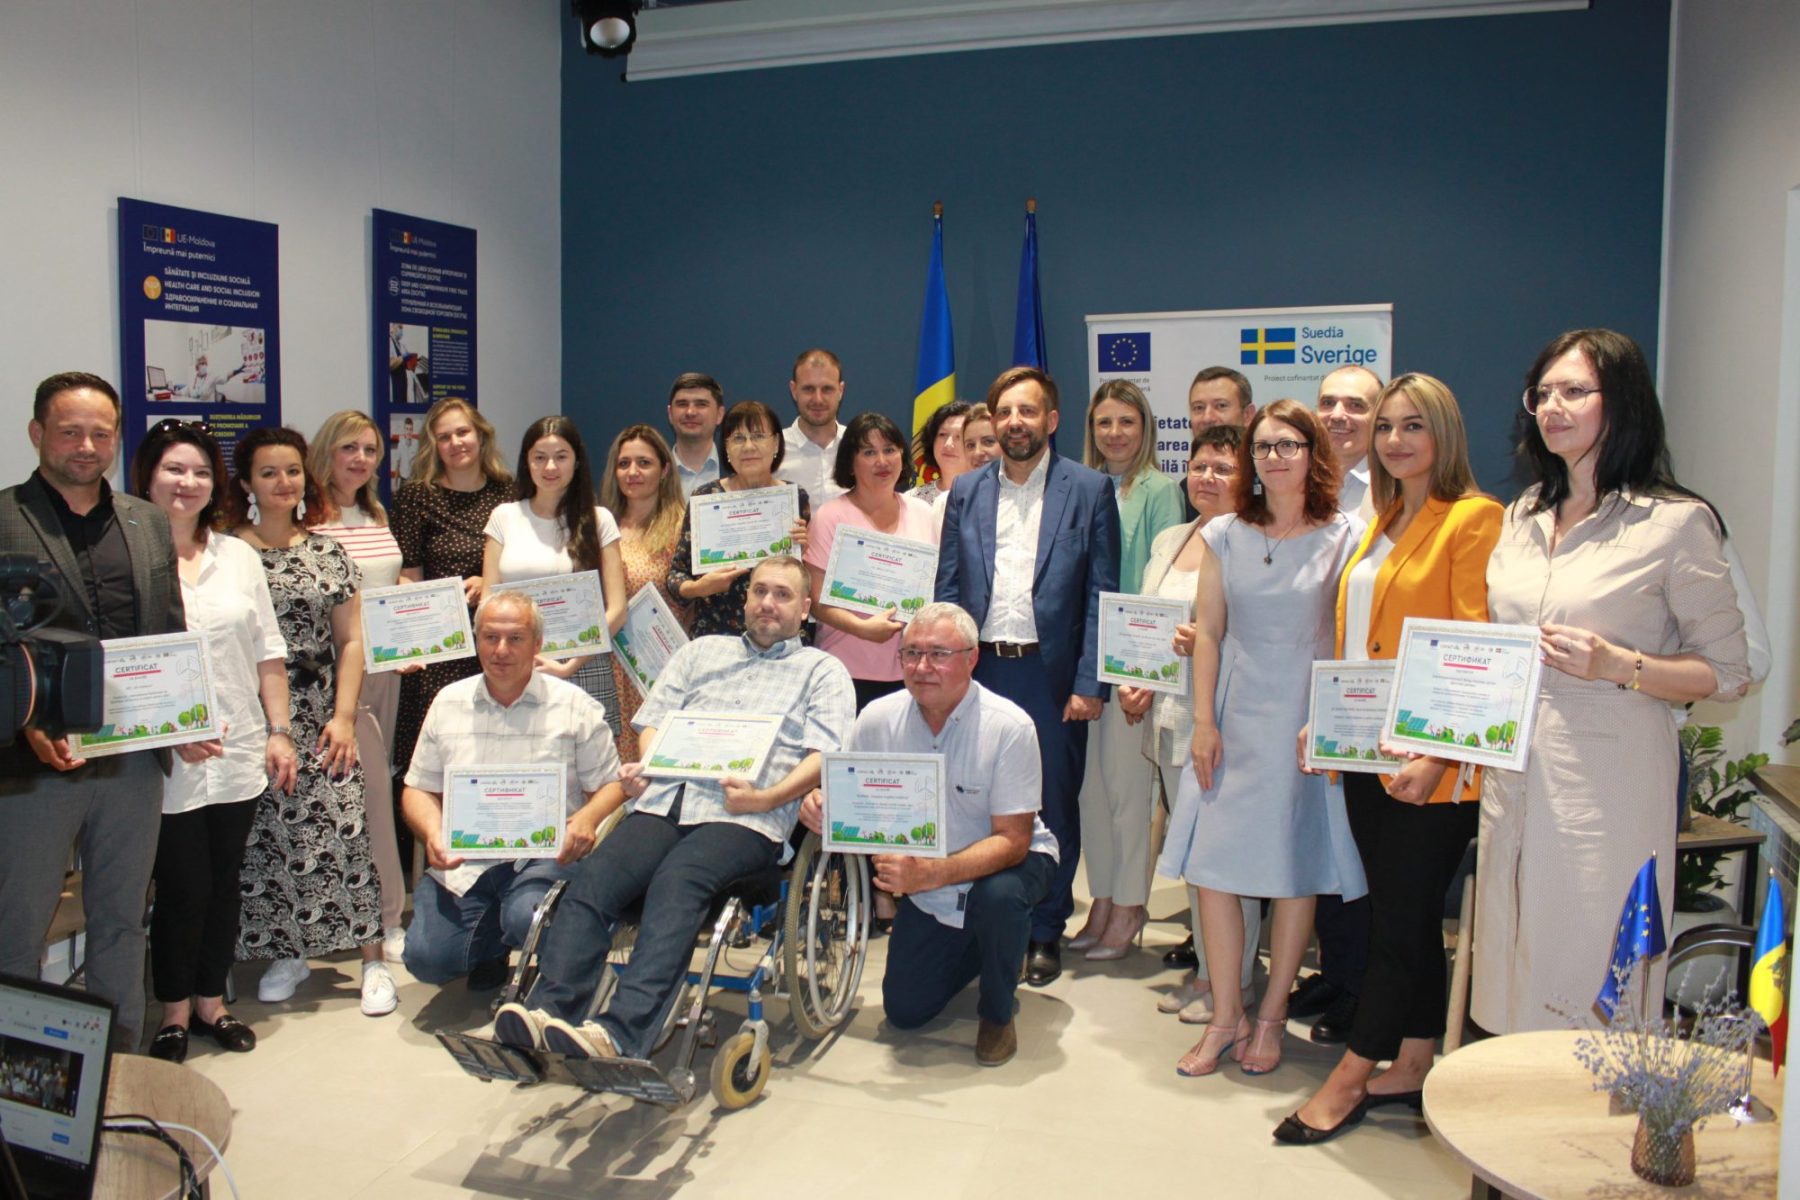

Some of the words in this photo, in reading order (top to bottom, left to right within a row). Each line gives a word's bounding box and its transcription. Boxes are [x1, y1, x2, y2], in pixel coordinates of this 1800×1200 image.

[143, 241, 175, 256] Împreună
[176, 250, 188, 258] mai
[188, 251, 216, 262] puternici
[164, 280, 185, 290] HEALTH
[186, 282, 200, 291] CARE
[201, 284, 212, 293] AND
[213, 286, 232, 295] SOCIAL
[233, 288, 260, 298] INCLUSION
[1302, 326, 1344, 339] Suedia
[1301, 344, 1377, 366] Sverige
[1157, 441, 1189, 451] area
[1161, 459, 1179, 473] ilă
[1442, 654, 1492, 666] СЕРТИФИКАТ
[115, 663, 158, 674] CERTIFICAT
